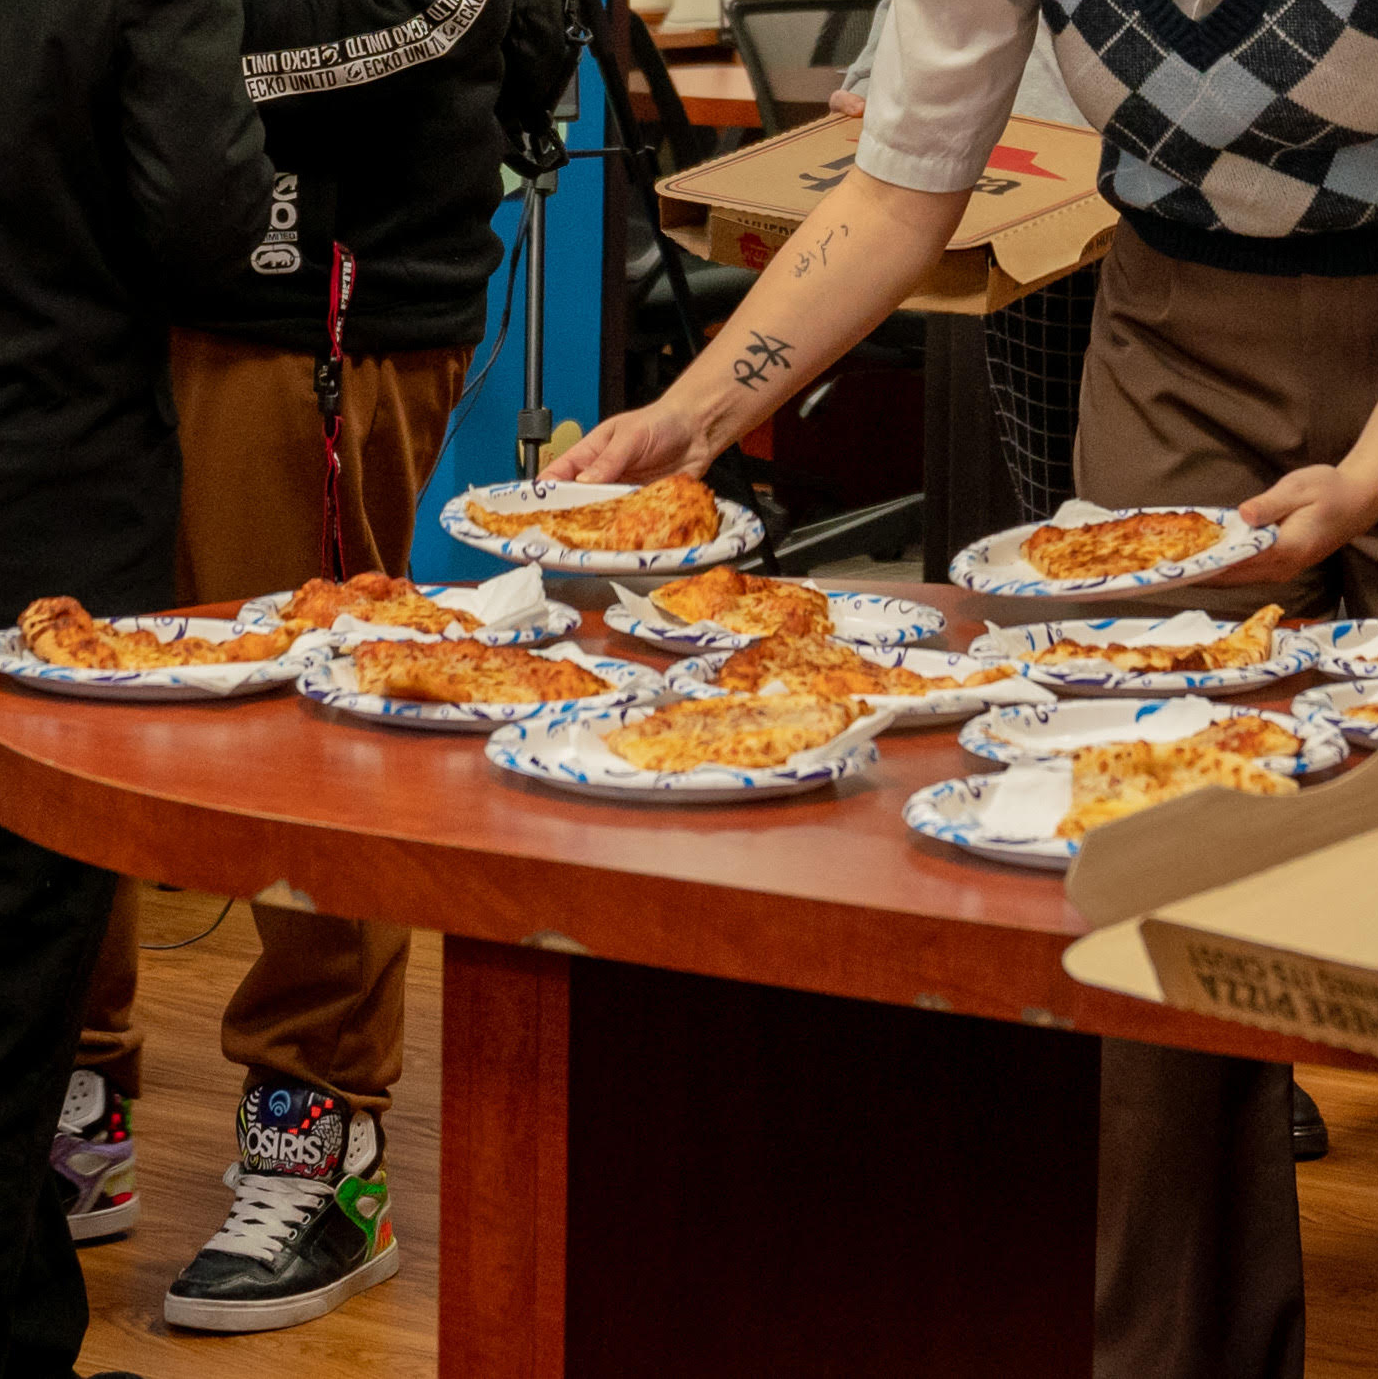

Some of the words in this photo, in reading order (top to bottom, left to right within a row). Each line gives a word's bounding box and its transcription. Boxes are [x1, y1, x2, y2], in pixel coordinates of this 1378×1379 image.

[345, 30, 393, 59] UNLTD
[242, 53, 279, 76] UNLT
[289, 69, 337, 92] UNLTD
[1194, 971, 1301, 1023] PIZZA
[246, 1125, 323, 1165] OSIRIS
